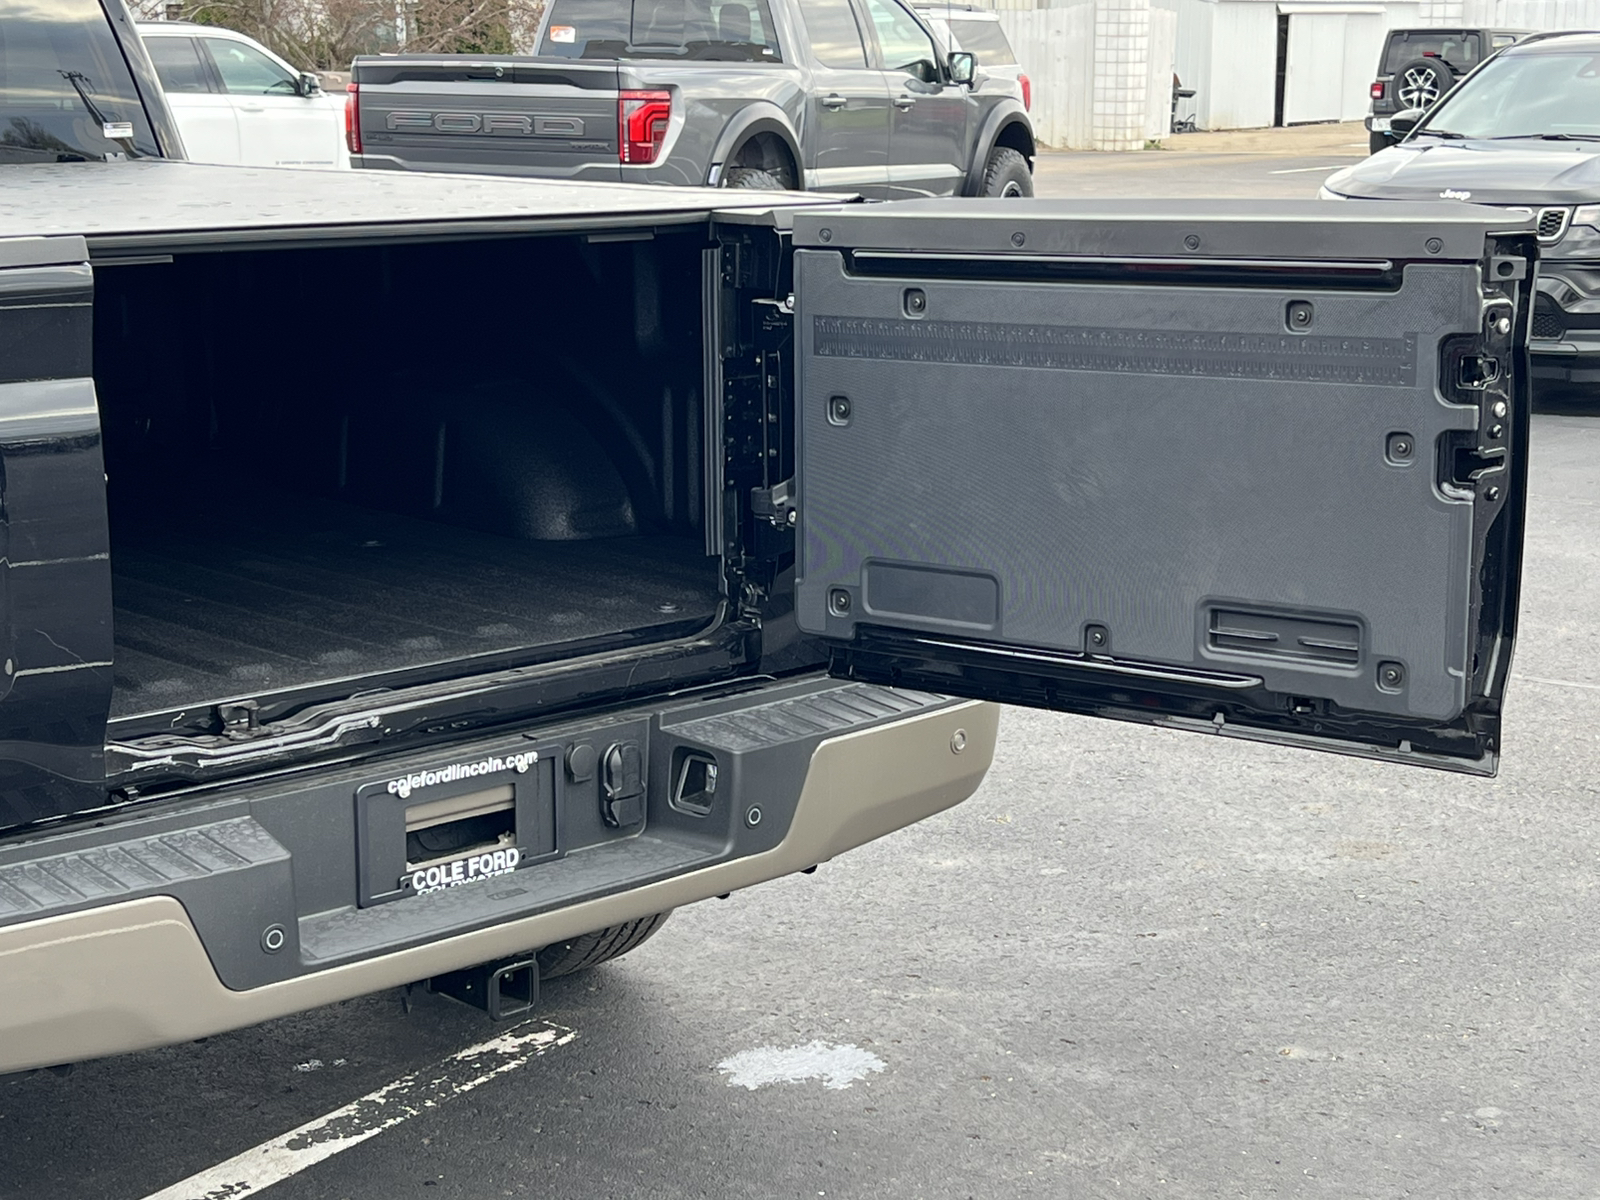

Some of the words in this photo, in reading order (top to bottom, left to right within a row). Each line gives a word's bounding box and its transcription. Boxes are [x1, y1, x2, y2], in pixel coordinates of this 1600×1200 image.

[386, 112, 585, 135] FORD
[1439, 188, 1471, 201] Jeep
[387, 750, 538, 795] colefordlincoln.com
[412, 860, 465, 890] COLE
[467, 847, 519, 877] FORD
